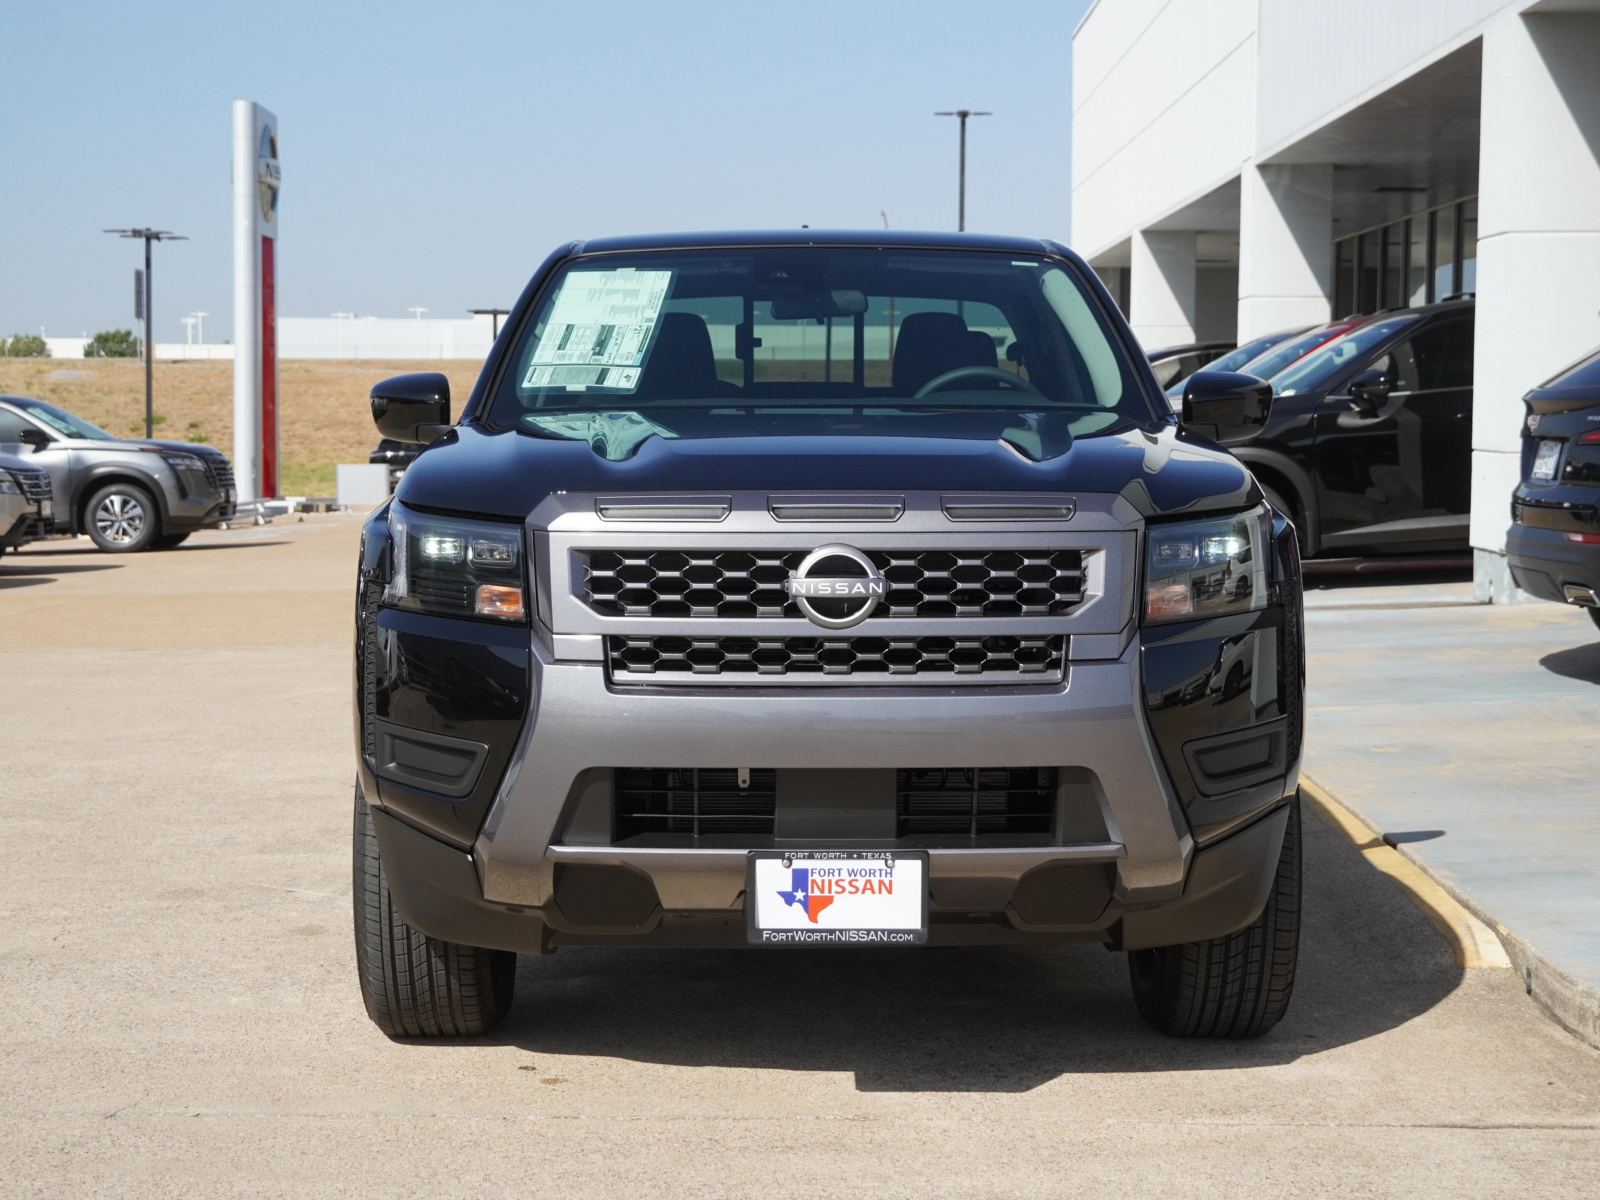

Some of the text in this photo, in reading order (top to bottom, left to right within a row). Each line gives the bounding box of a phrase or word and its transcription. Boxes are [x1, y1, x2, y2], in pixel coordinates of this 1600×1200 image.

[792, 582, 883, 594] NISSAN
[784, 852, 892, 860] FORT WORTH TEXAS
[810, 868, 893, 878] FORT WORTH
[810, 878, 893, 895] NISSAN
